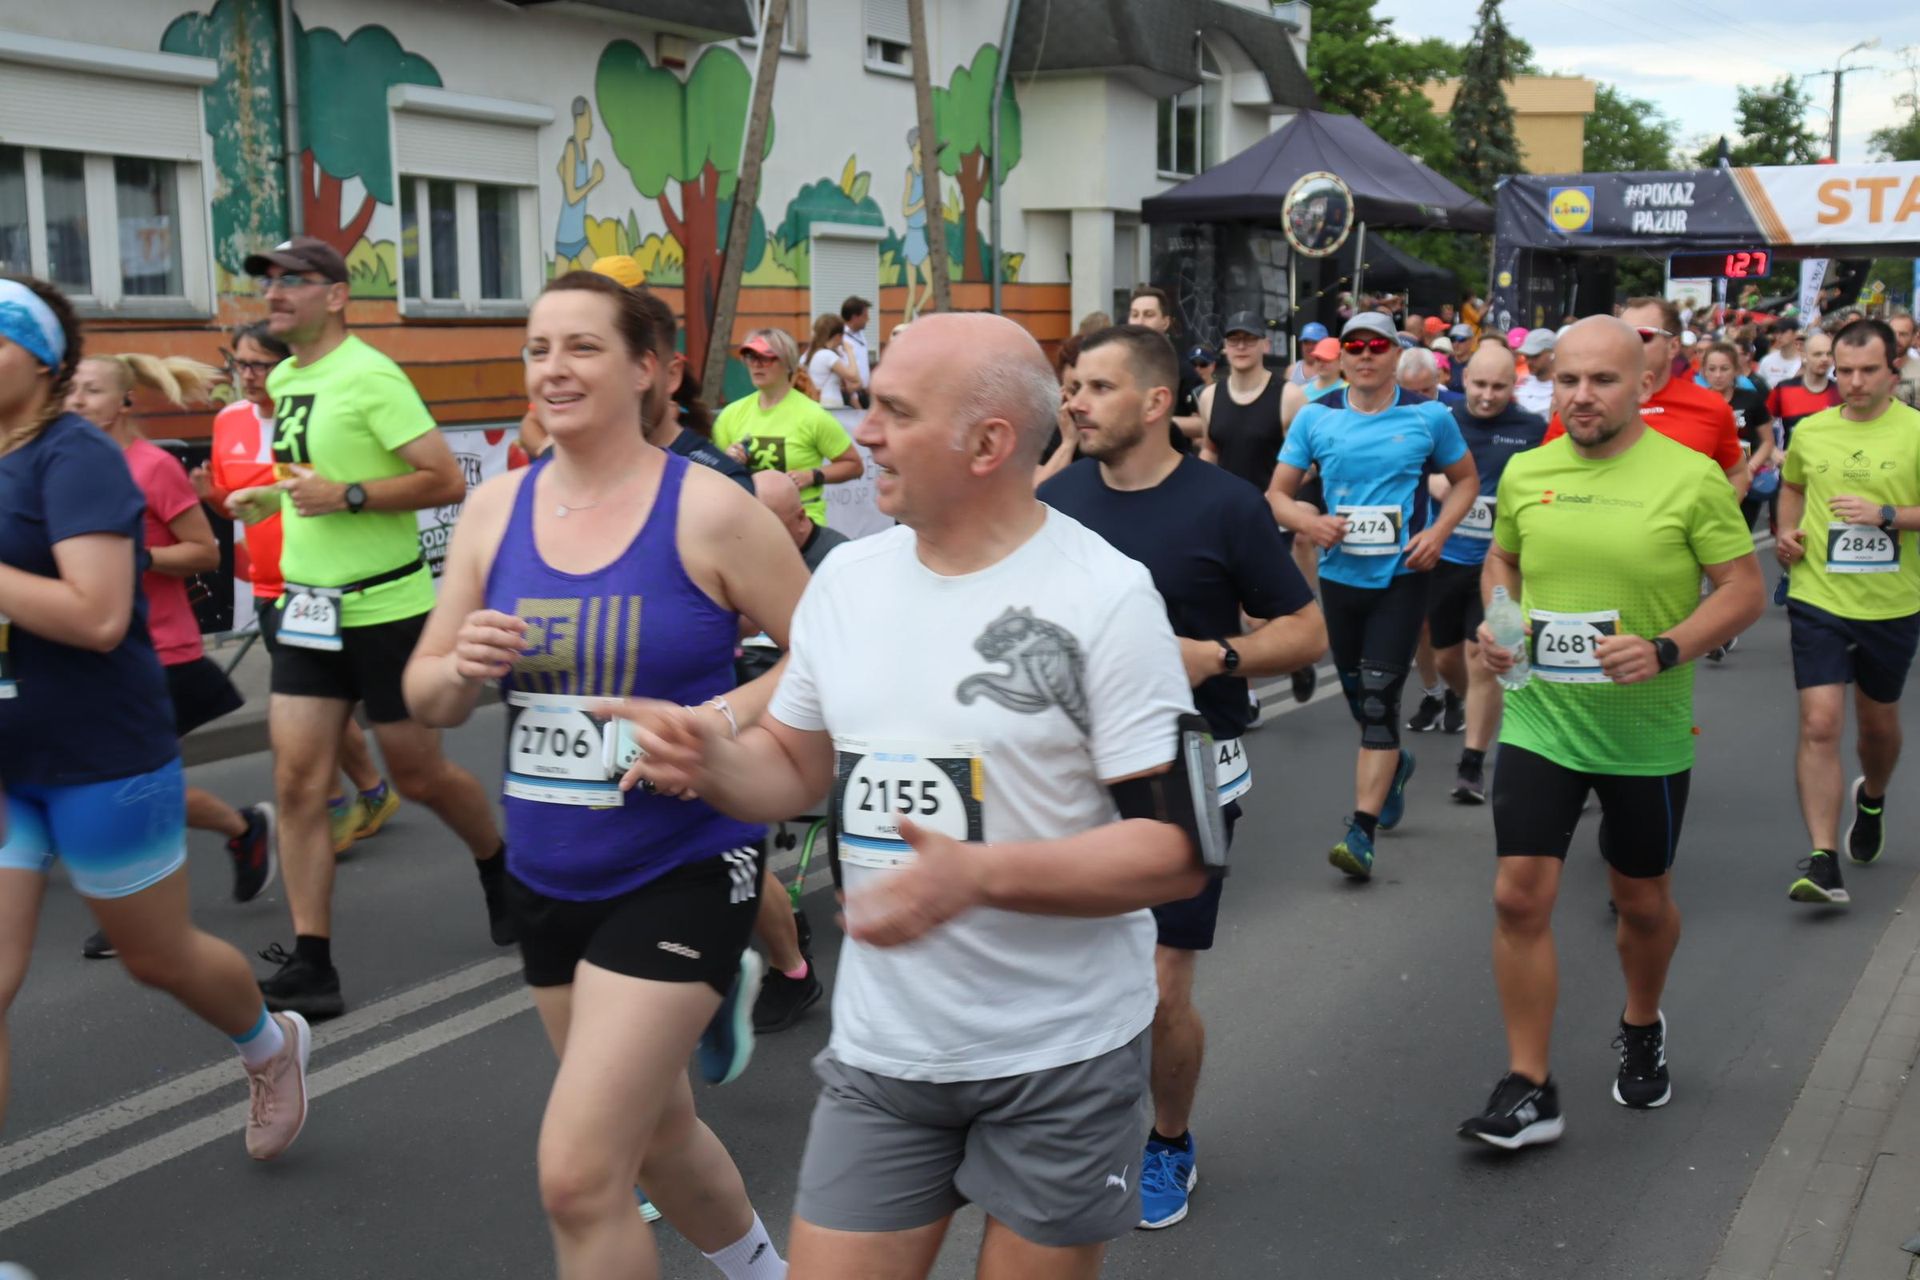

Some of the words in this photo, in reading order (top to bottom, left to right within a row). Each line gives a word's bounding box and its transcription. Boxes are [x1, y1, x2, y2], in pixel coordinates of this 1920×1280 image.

[1348, 520, 1387, 534] 2474
[1841, 537, 1888, 552] 2845
[1545, 633, 1597, 653] 2681
[519, 724, 590, 759] 2706
[1218, 739, 1240, 766] 44
[858, 776, 939, 815] 2155
[657, 941, 701, 959] adidas
